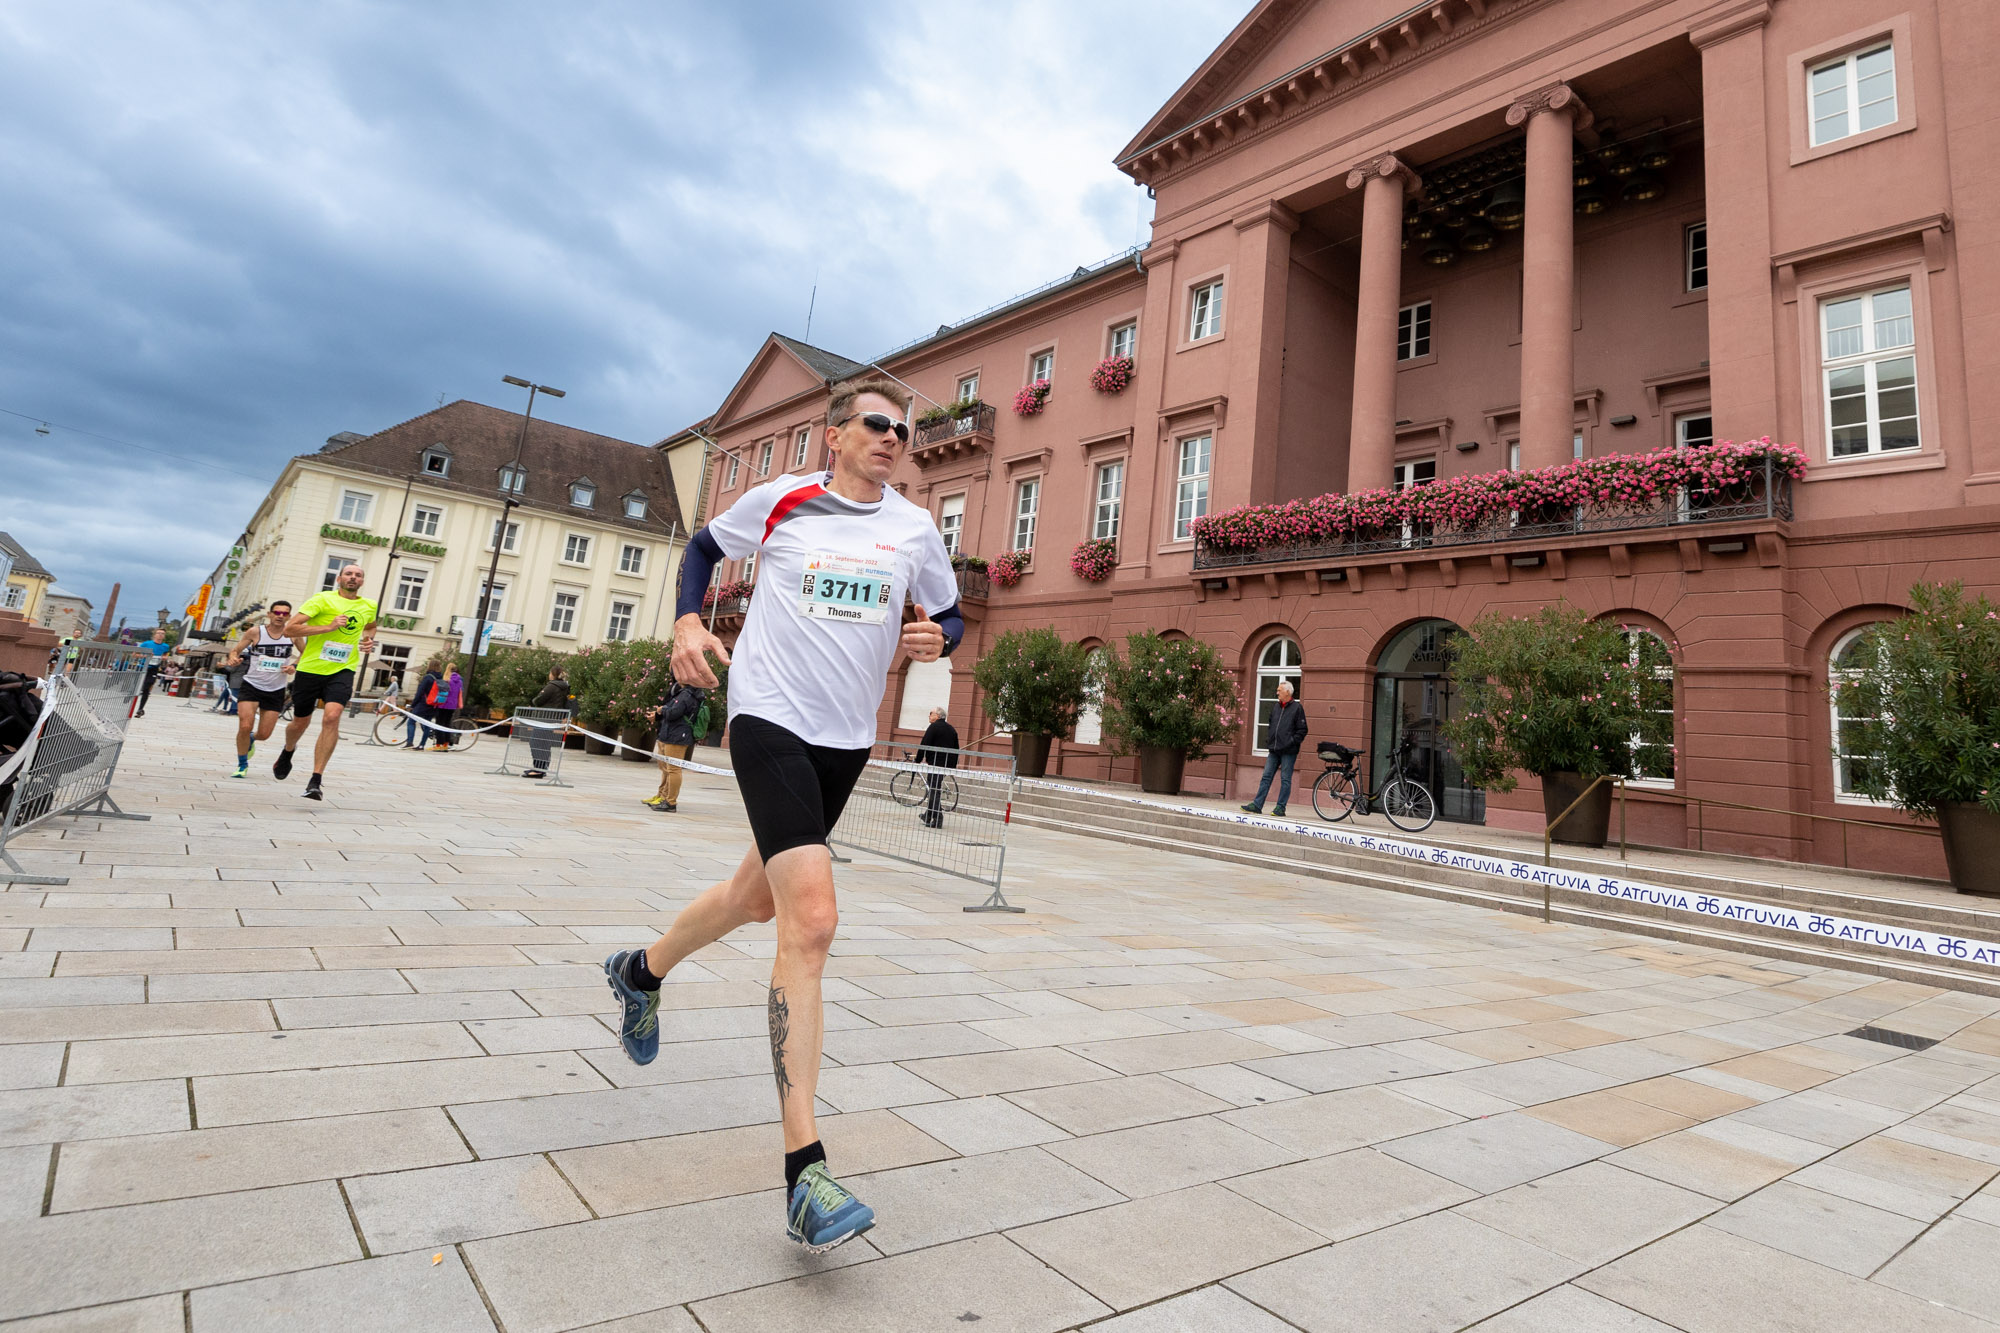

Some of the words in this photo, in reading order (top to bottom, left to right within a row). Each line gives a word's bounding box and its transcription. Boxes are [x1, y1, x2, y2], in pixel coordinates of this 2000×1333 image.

[835, 555, 864, 565] September
[218, 546, 244, 611] HOTEL
[820, 579, 872, 603] 3711
[827, 606, 862, 619] Thomas
[1972, 947, 2000, 964] AT
